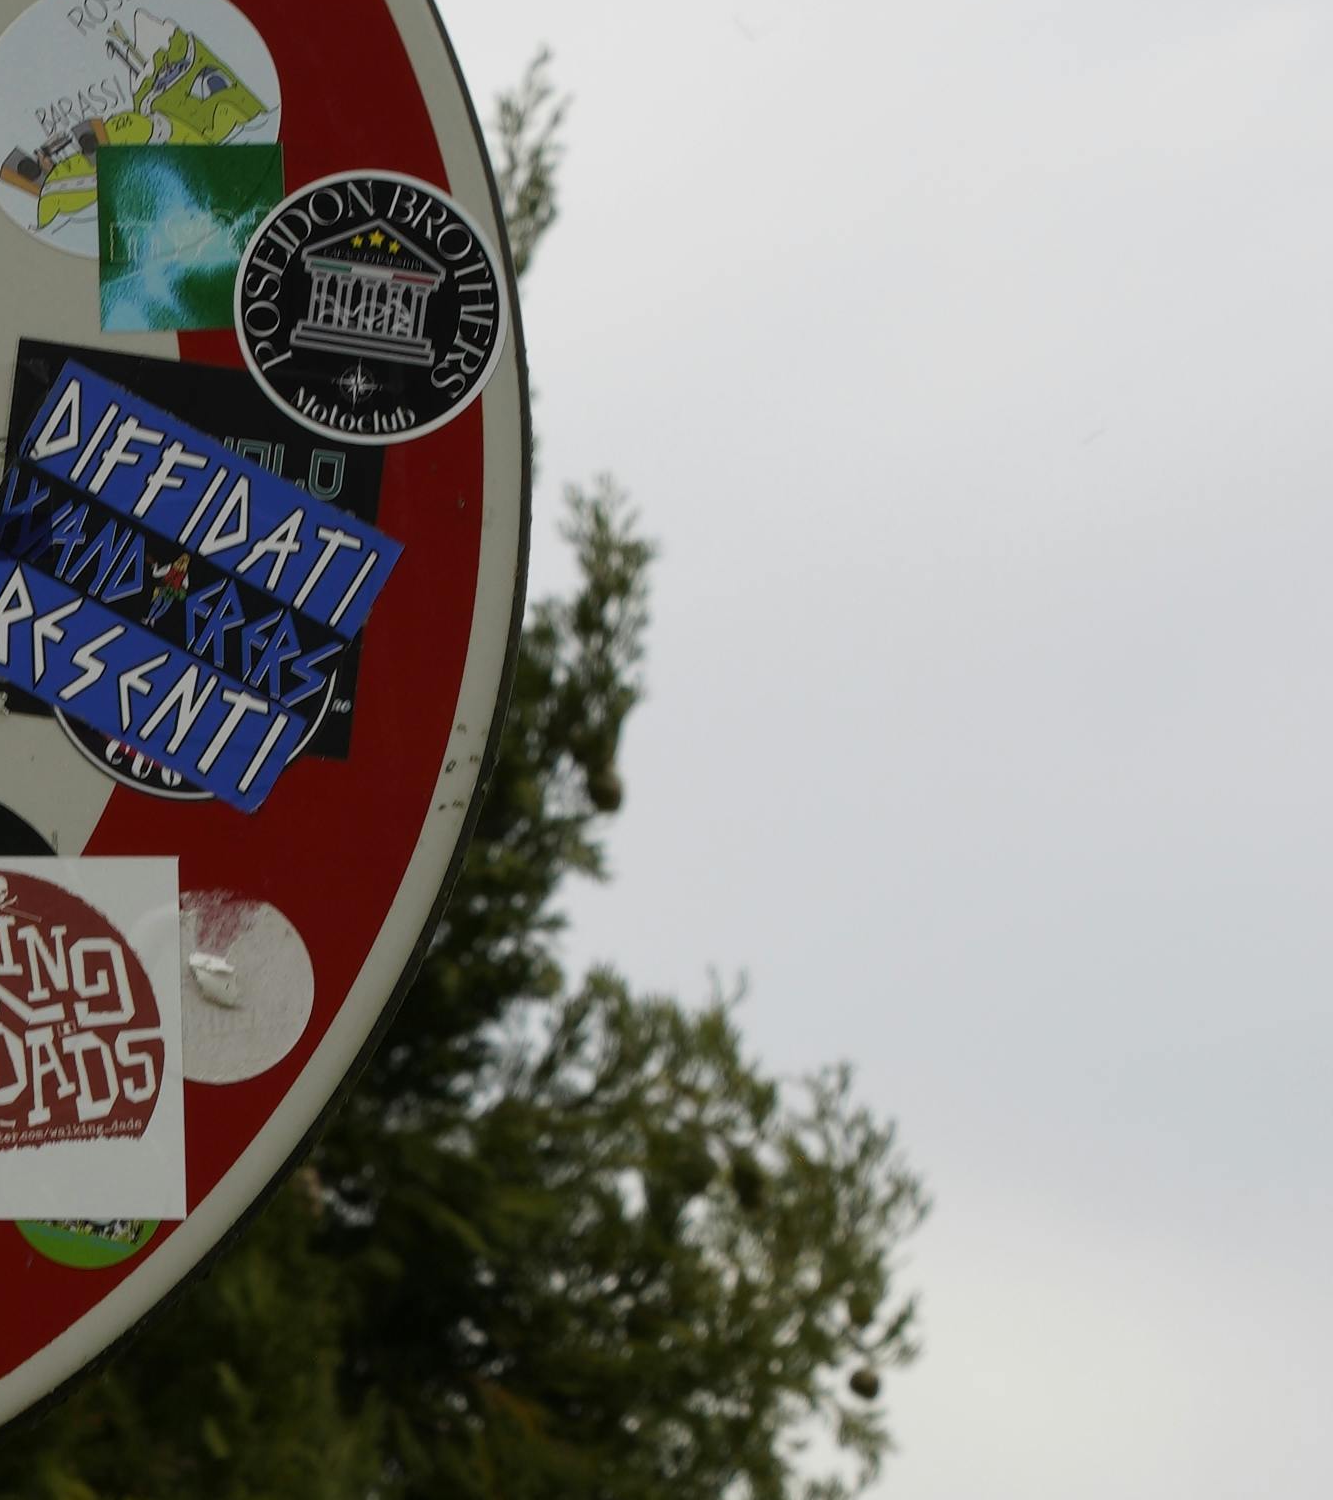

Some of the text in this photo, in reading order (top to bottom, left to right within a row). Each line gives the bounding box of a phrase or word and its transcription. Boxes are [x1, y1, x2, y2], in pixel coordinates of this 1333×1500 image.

[34, 76, 127, 138] BARASSI
[242, 180, 496, 400] POSEIDON BROTHERS
[288, 386, 417, 435] Motoclub
[28, 376, 379, 630] DIFFIDATI
